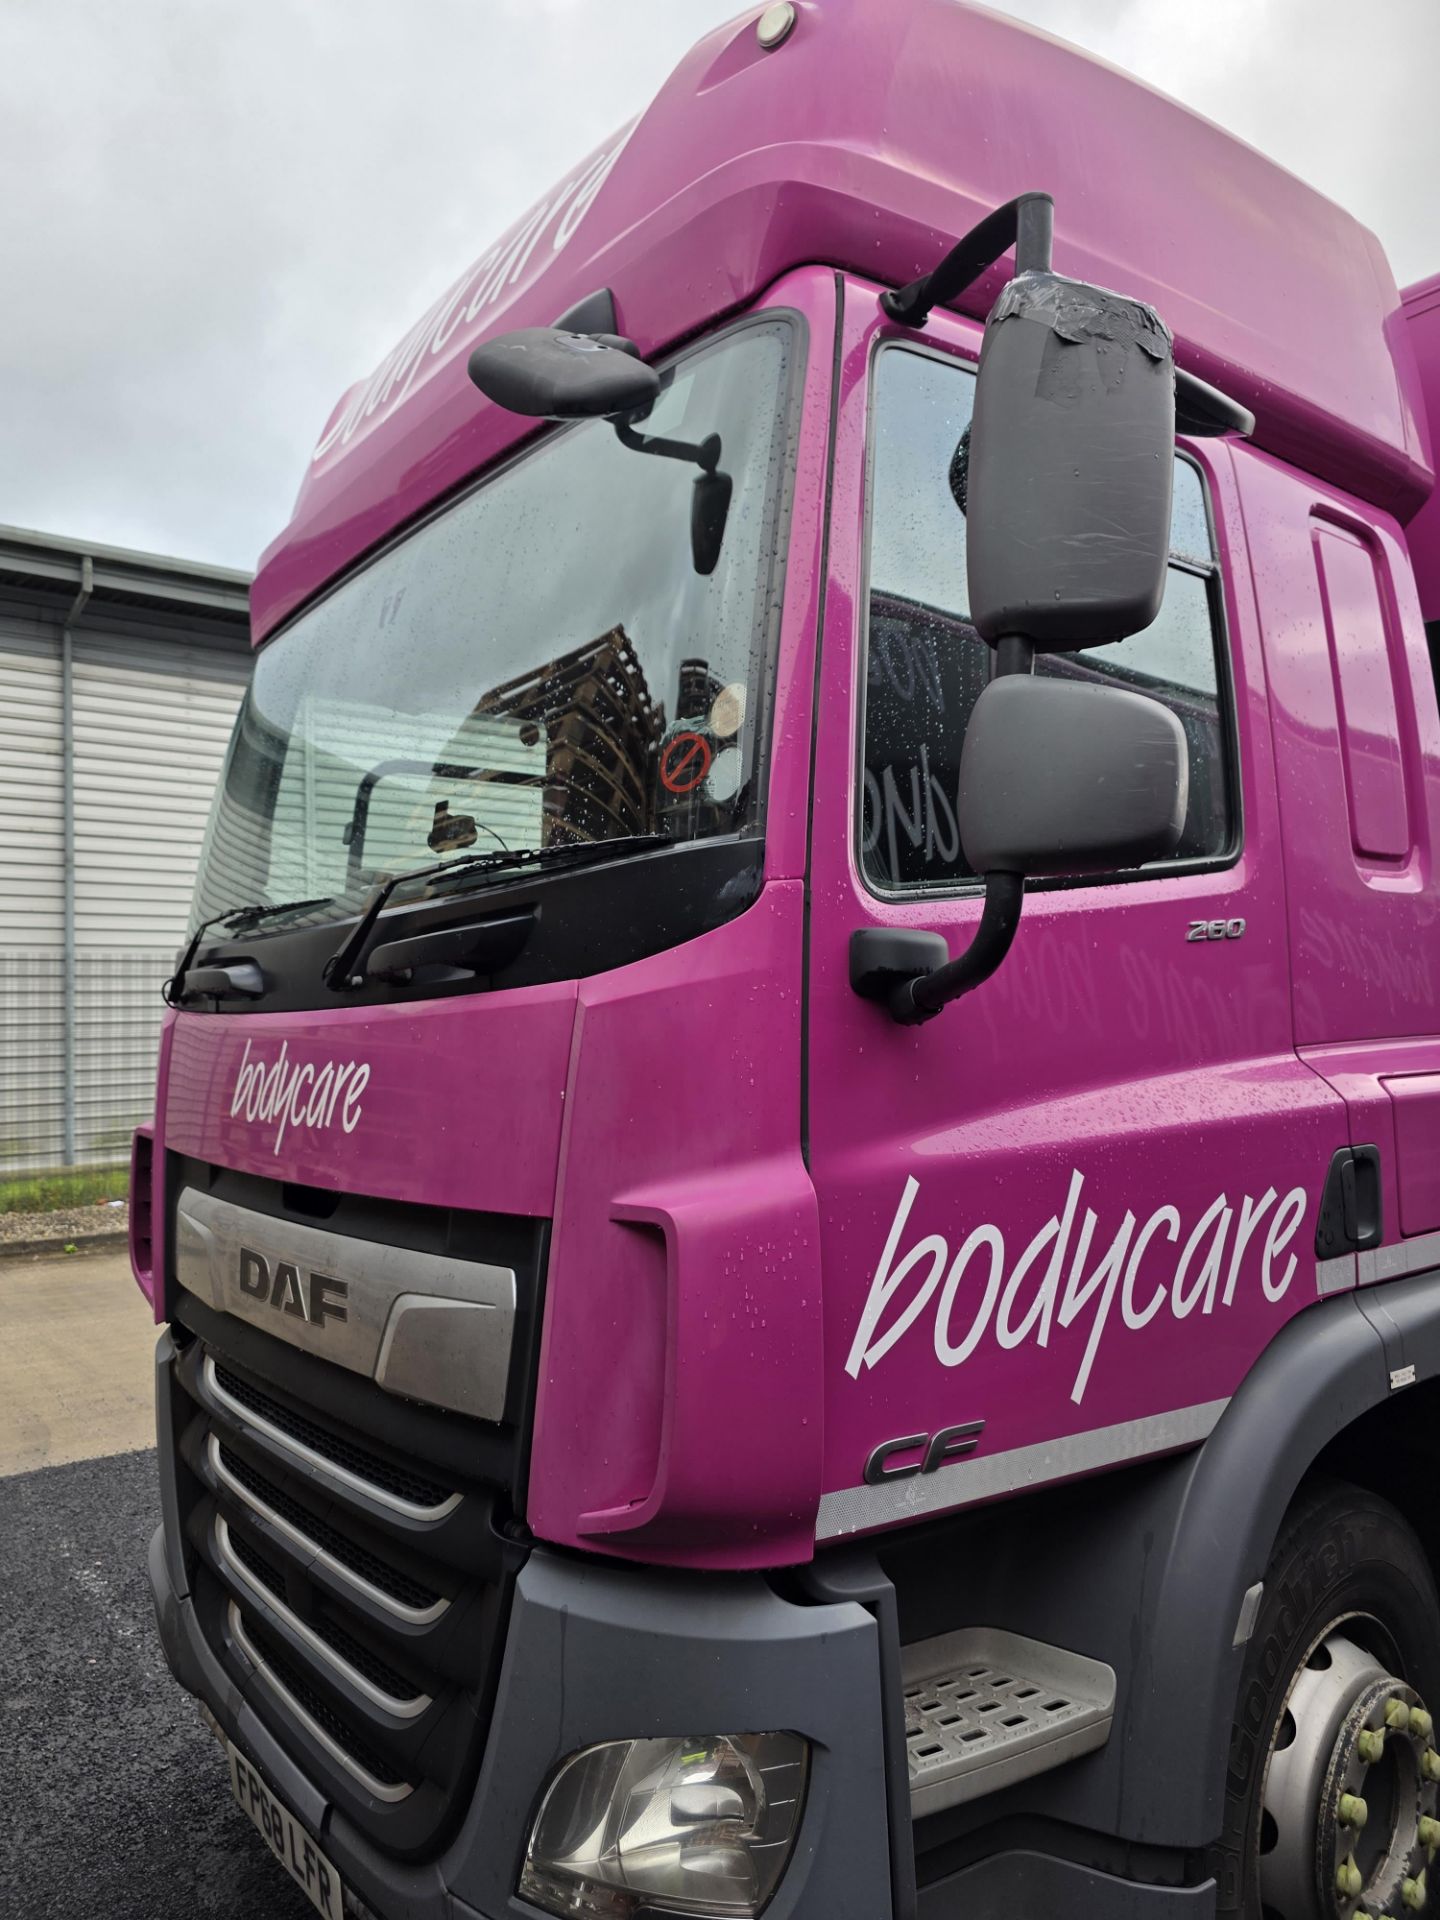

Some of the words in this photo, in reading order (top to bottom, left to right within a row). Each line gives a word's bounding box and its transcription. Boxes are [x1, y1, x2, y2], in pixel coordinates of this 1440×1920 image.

[1185, 918, 1246, 941] 260
[230, 1038, 370, 1156] bodycare
[240, 1246, 349, 1329] DAF
[844, 1168, 1307, 1404] bodycare
[863, 1419, 986, 1485] CF
[234, 1756, 285, 1855] FP68
[288, 1821, 333, 1920] LFR
